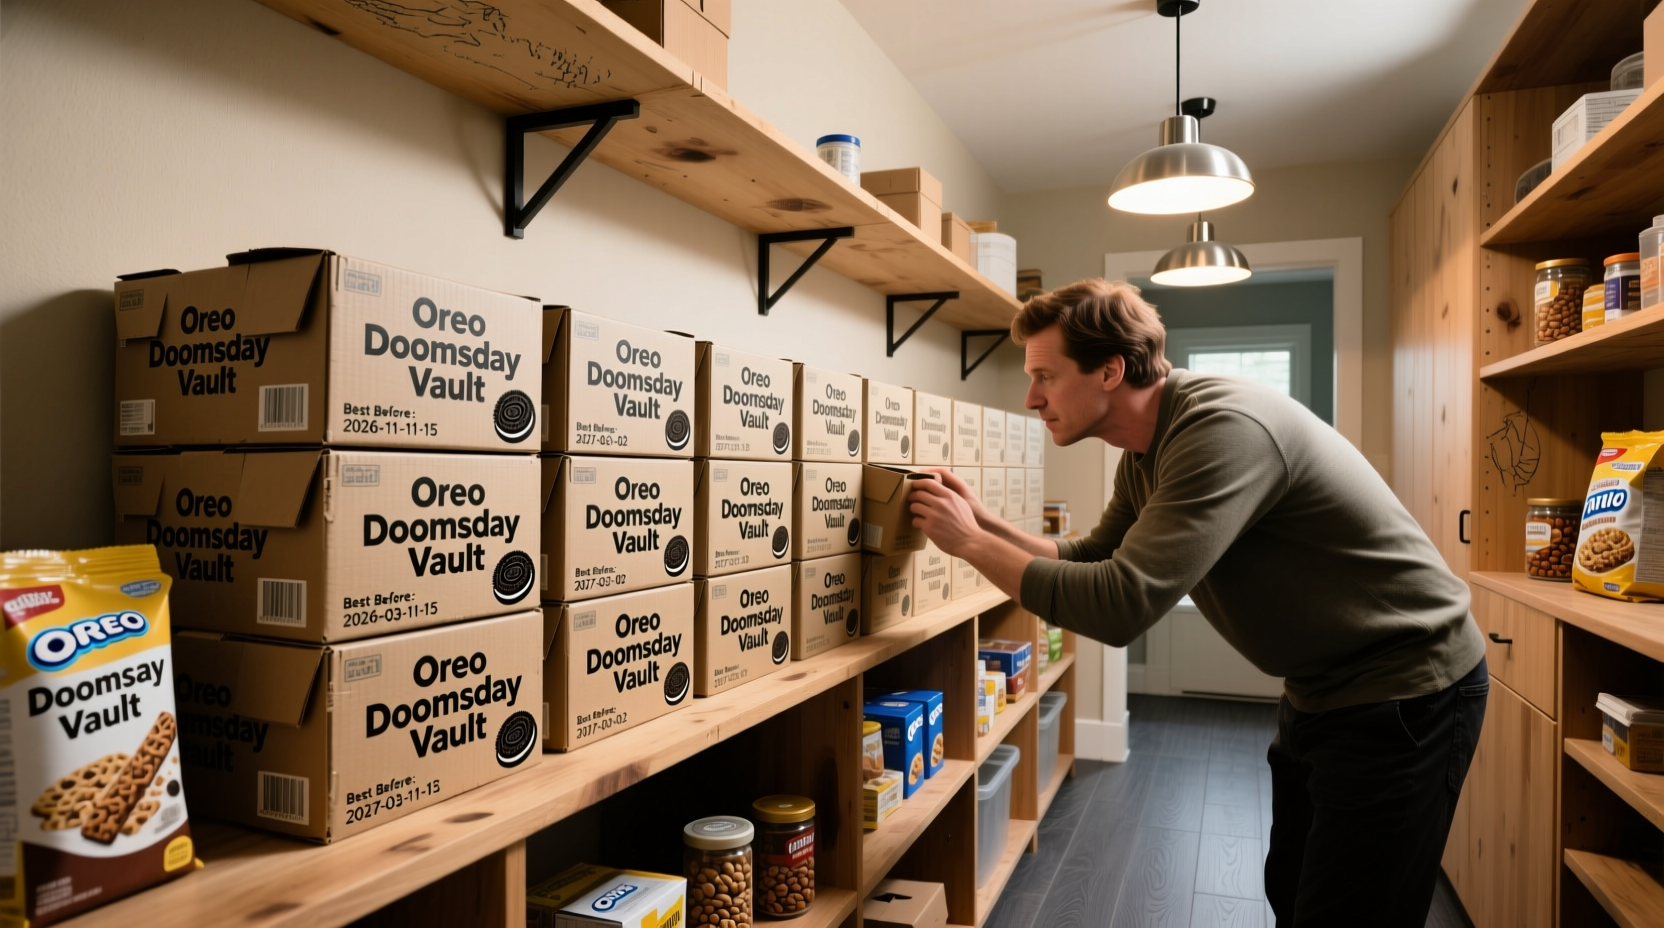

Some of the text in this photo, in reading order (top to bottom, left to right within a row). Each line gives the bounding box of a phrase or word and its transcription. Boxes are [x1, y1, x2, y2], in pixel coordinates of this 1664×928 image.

[181, 305, 235, 334] Oreo
[412, 297, 486, 337] Oreo
[149, 333, 270, 368] Doomsday
[364, 323, 521, 381] Doomsday
[616, 339, 661, 369] Oreo
[178, 366, 236, 396] Vault
[408, 366, 485, 402] Vault
[587, 361, 683, 402] Doomsday
[741, 366, 770, 388] Oreo
[343, 402, 370, 416] Best
[613, 392, 660, 420] Vault
[723, 384, 784, 416] Doomsday
[343, 418, 438, 436] 2026-11-11-15
[740, 409, 769, 430] Vault
[411, 476, 485, 507] Oreo
[615, 476, 660, 500] Oreo
[740, 477, 770, 496] Oreo
[176, 488, 232, 518] Oreo
[586, 502, 682, 530] Doomsday
[722, 497, 783, 520] Doomsday
[147, 519, 268, 560] Doomsday
[363, 508, 520, 546] Doomsday
[612, 528, 659, 554] Vault
[739, 519, 769, 540] Vault
[174, 552, 234, 583] Vault
[408, 542, 485, 577] Vault
[343, 596, 370, 609] Best
[740, 589, 769, 608] Oreo
[343, 601, 438, 627] 2026-03-11-15
[615, 613, 660, 638] Oreo
[721, 605, 783, 636] Doomsday
[33, 611, 146, 663] OREO
[738, 627, 769, 652] Vault
[587, 632, 682, 675] Doomsday
[413, 652, 487, 687] Oreo
[613, 661, 659, 693] Vault
[28, 659, 164, 718] Doomsay
[58, 693, 141, 740] Vault
[366, 675, 522, 739] Doomsday
[409, 712, 487, 758] Vault
[346, 787, 373, 805] Best
